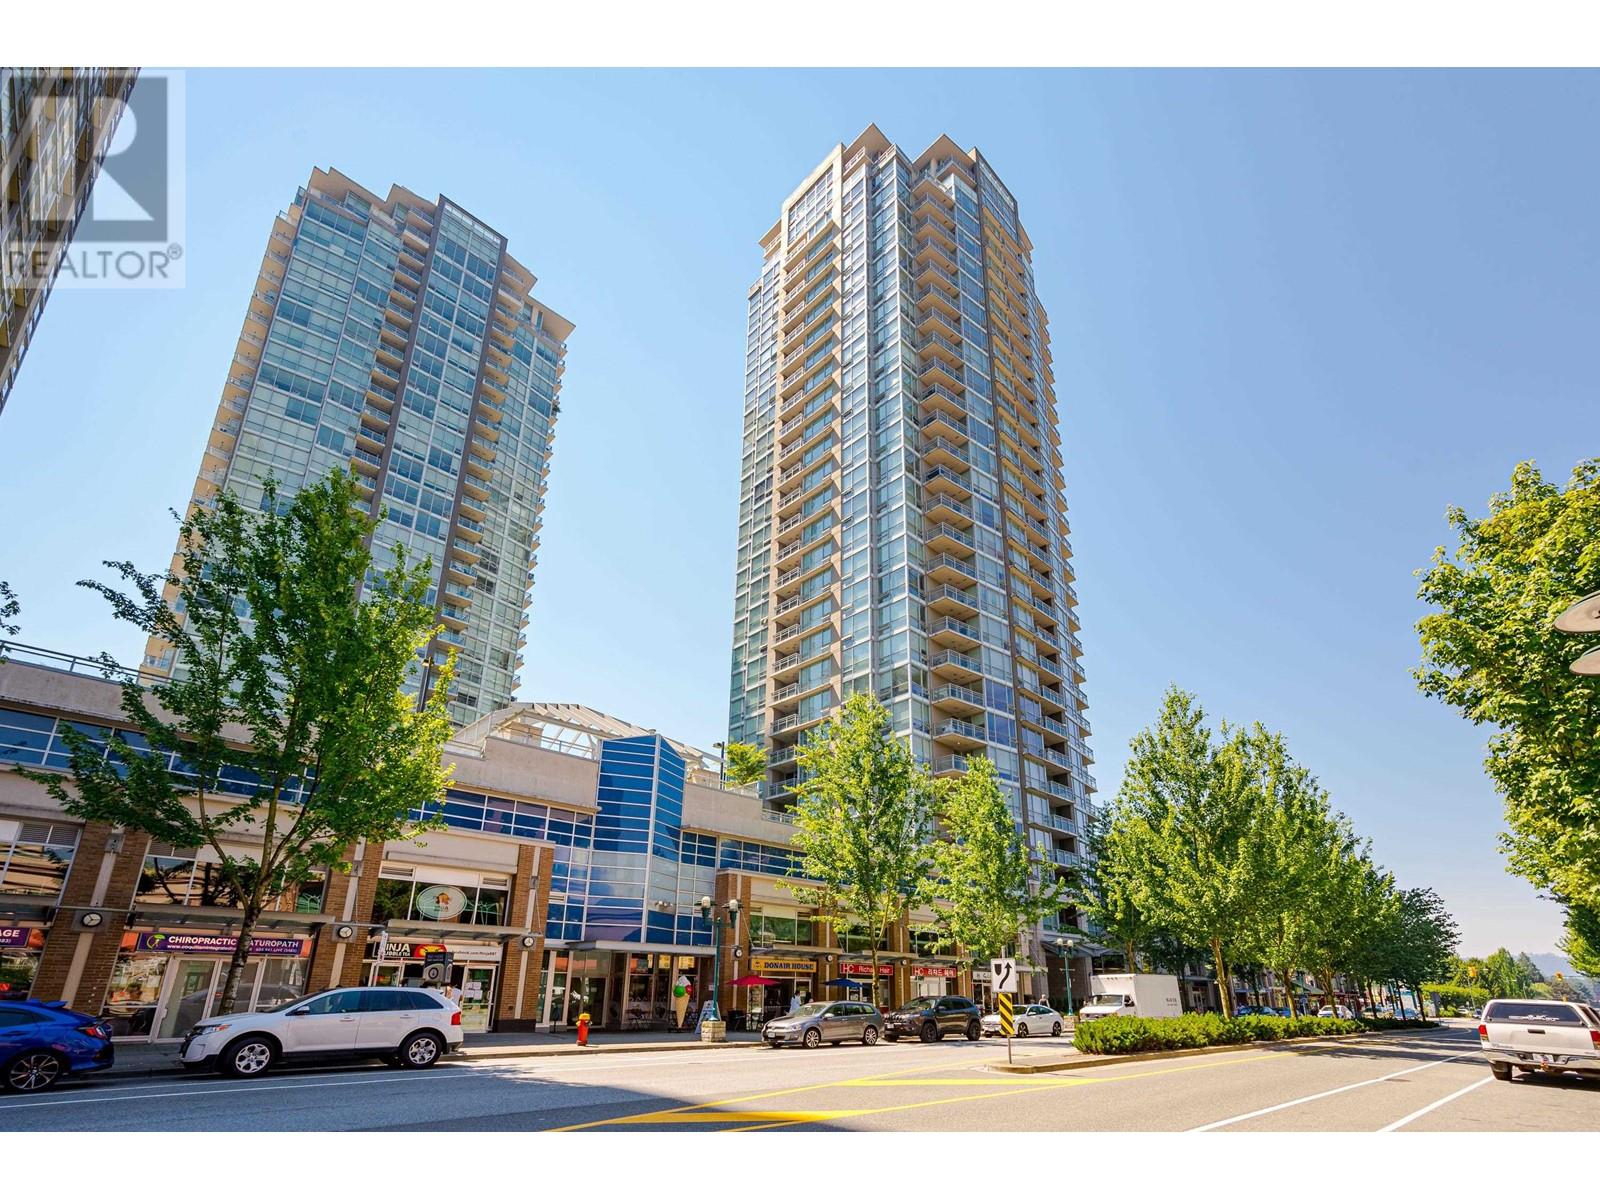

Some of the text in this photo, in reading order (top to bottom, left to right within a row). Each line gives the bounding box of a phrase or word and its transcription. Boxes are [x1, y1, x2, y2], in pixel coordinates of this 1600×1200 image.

[0, 929, 20, 937] GE
[168, 935, 237, 946] CHIROPRACTIC
[249, 939, 299, 948] ATUROPATH
[385, 943, 411, 953] INJA
[858, 965, 873, 973] Richa
